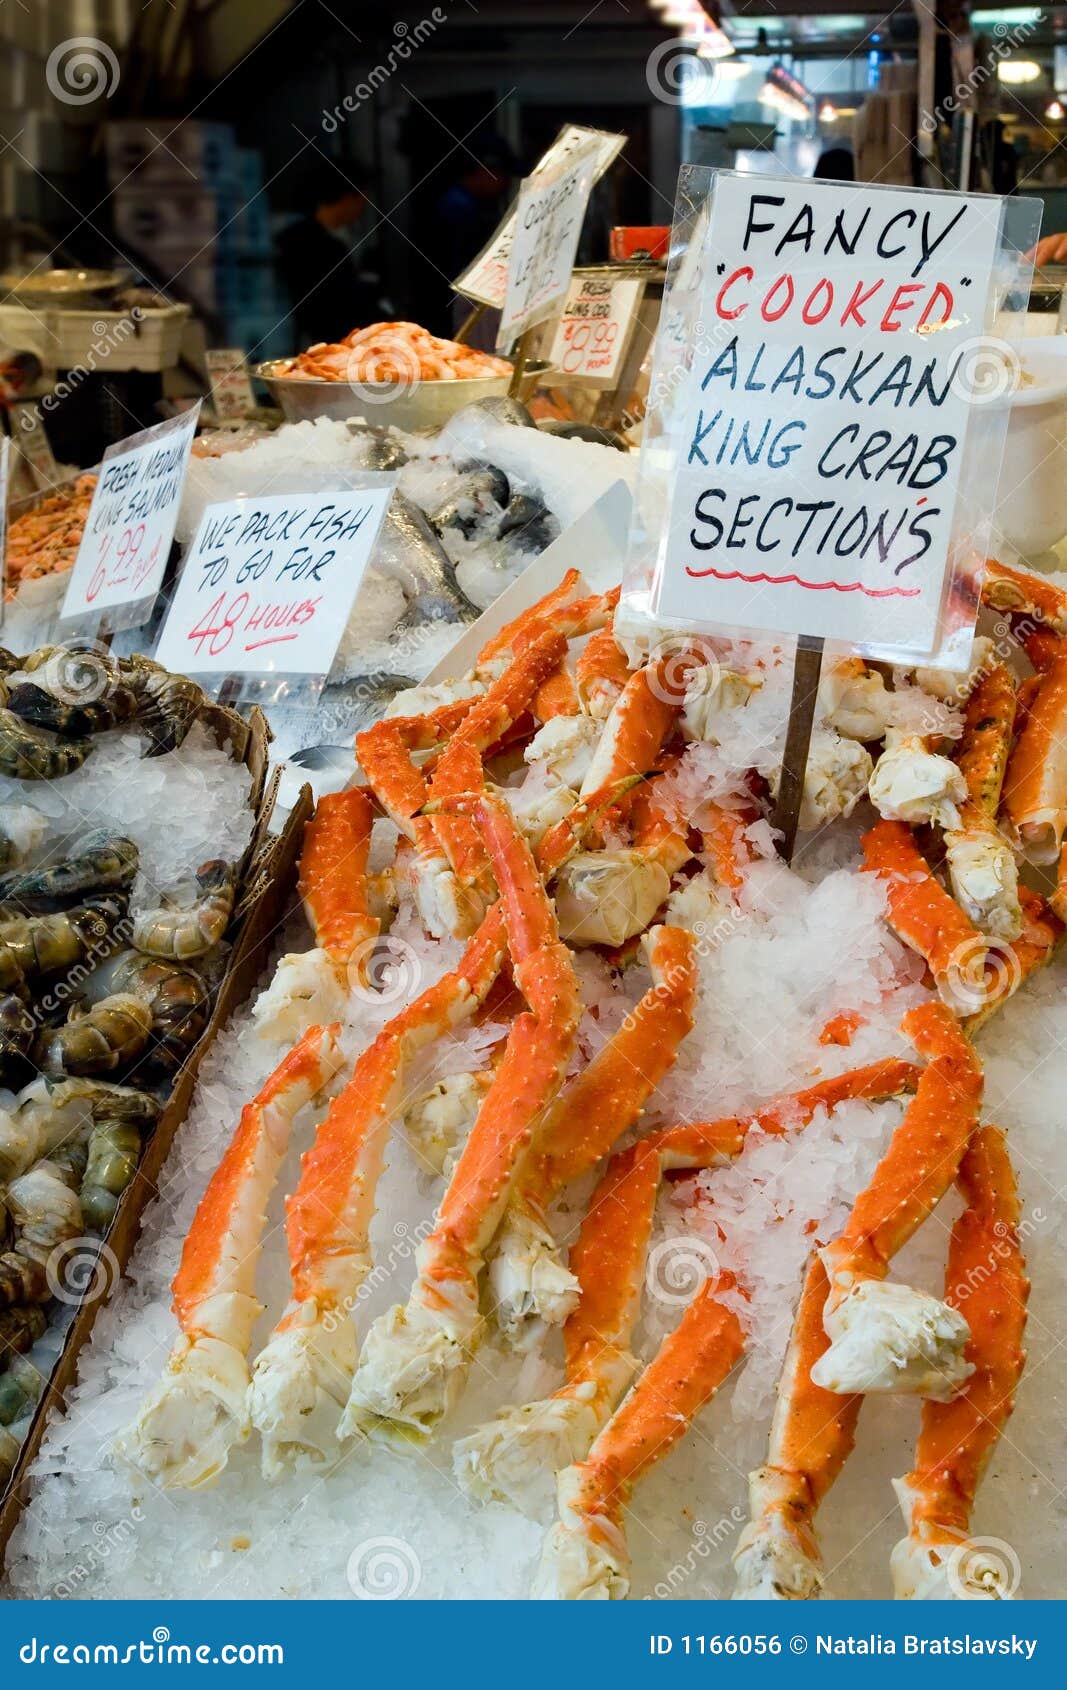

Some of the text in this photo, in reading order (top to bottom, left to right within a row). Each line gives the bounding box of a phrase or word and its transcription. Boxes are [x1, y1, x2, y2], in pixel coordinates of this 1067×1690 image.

[743, 194, 968, 278] FANCY
[701, 335, 964, 408] ALASKAN
[687, 409, 957, 490] KING CRAB
[123, 478, 178, 524] SALMON
[199, 505, 374, 554] WE PACK FISH
[198, 556, 230, 593] TO
[236, 549, 274, 585] GO
[275, 547, 336, 583] FOR
[187, 591, 324, 657] 48 HOURS
